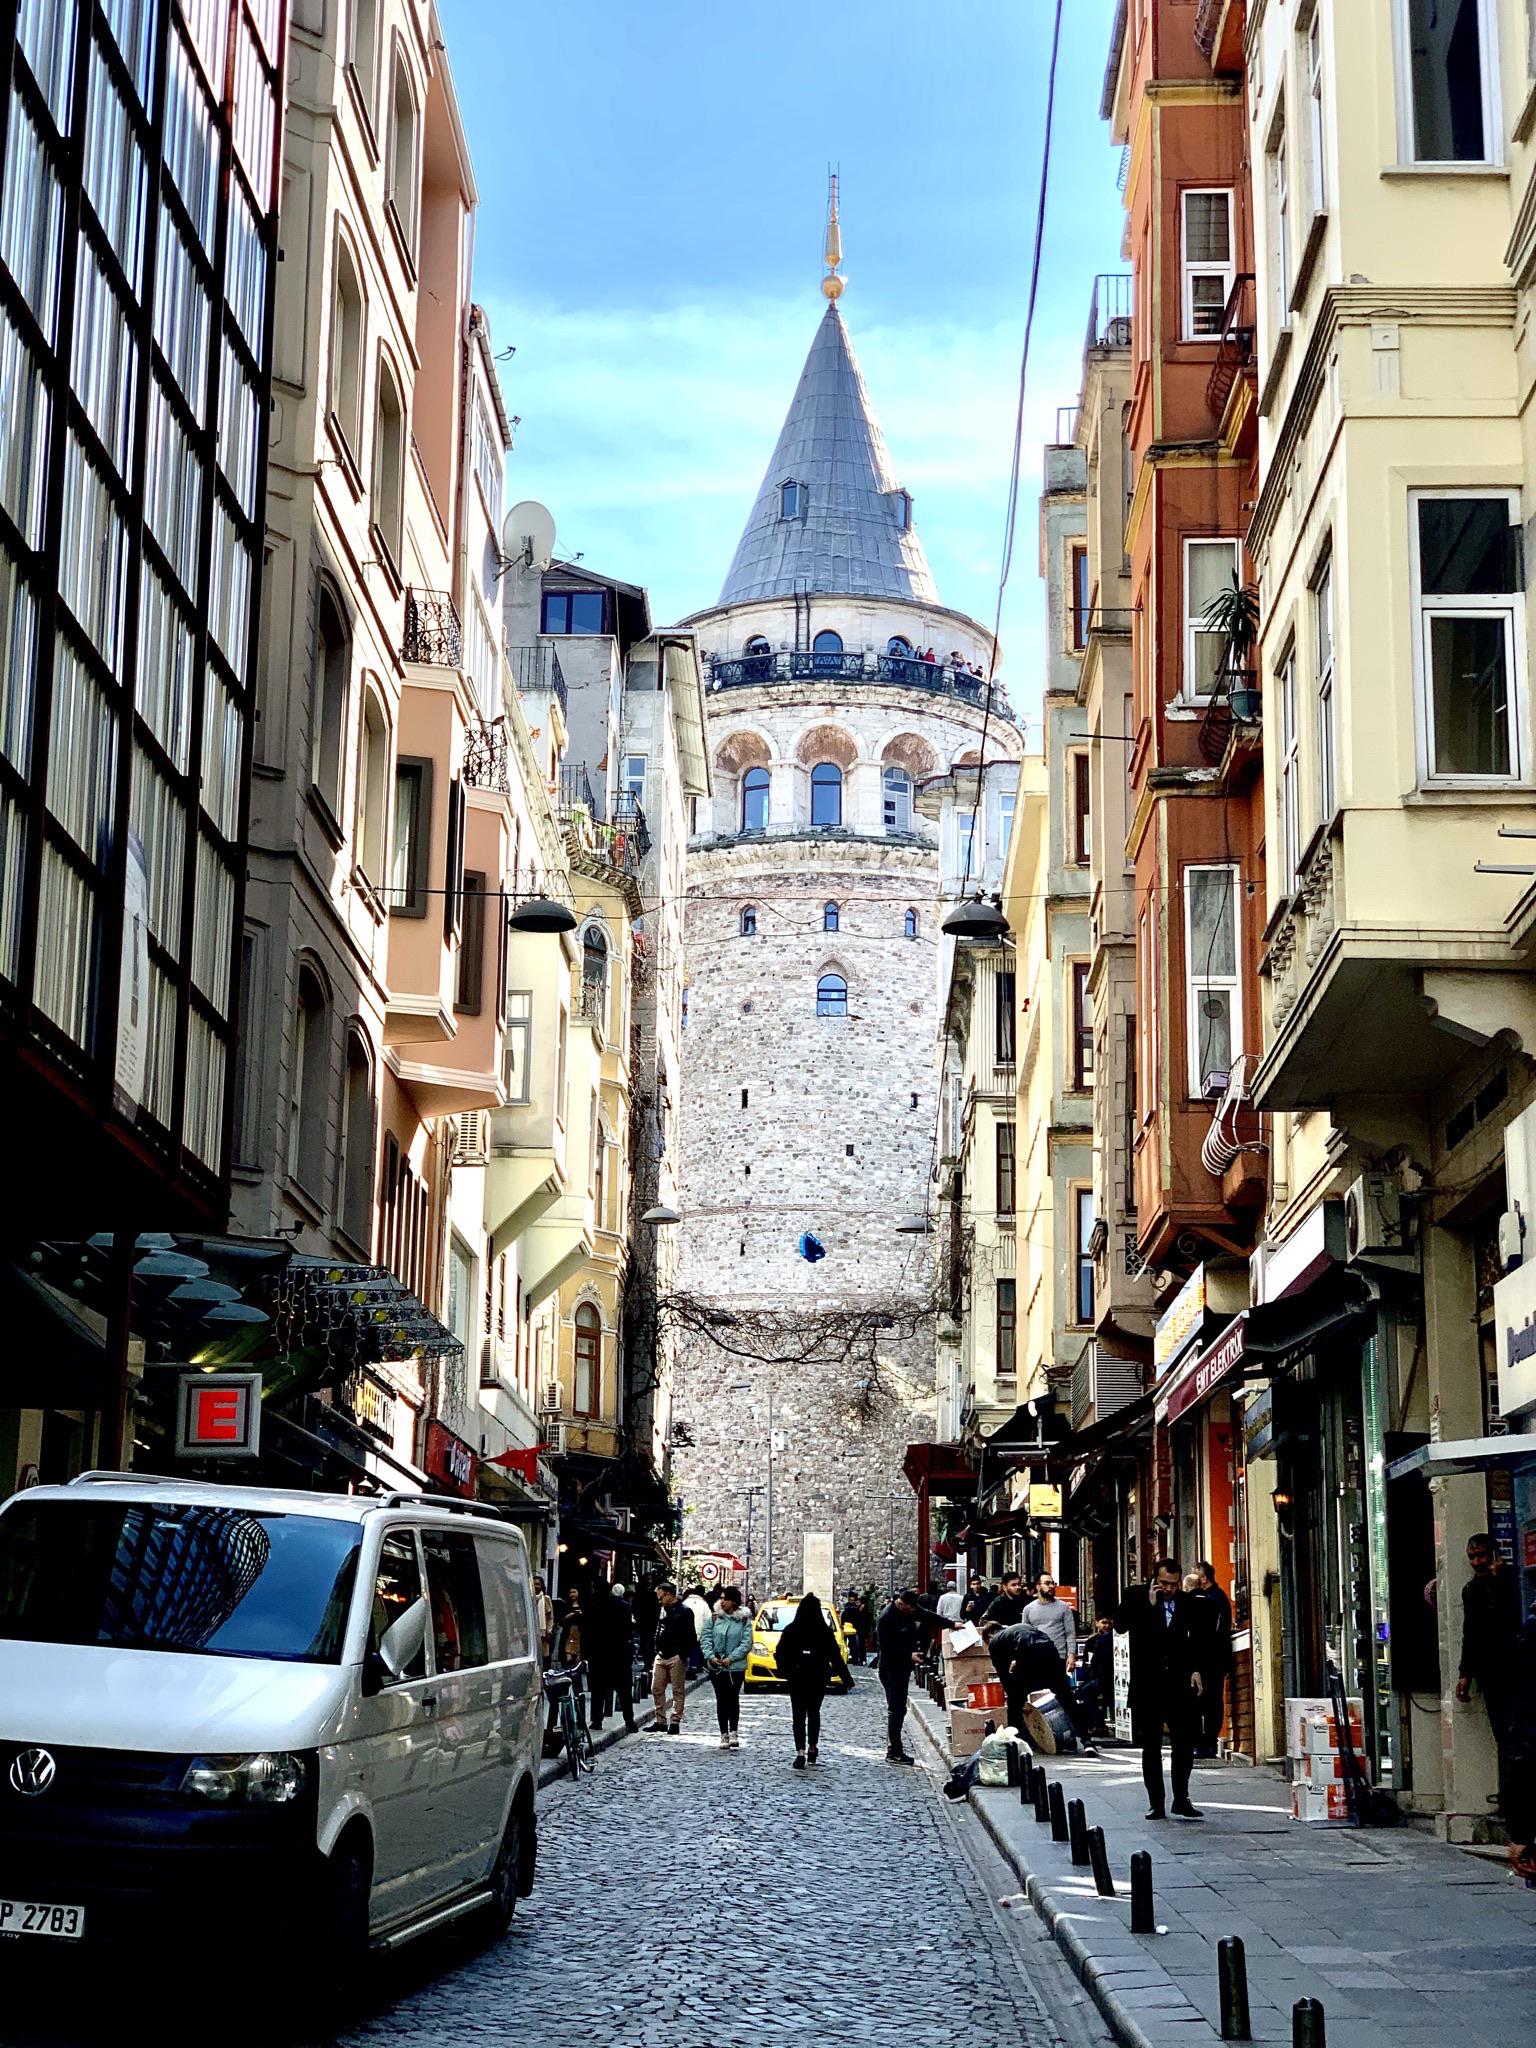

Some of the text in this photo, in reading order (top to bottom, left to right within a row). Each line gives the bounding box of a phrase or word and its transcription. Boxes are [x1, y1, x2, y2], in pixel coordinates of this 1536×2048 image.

[197, 1391, 239, 1440] E
[0, 1902, 79, 1934] P 2783
